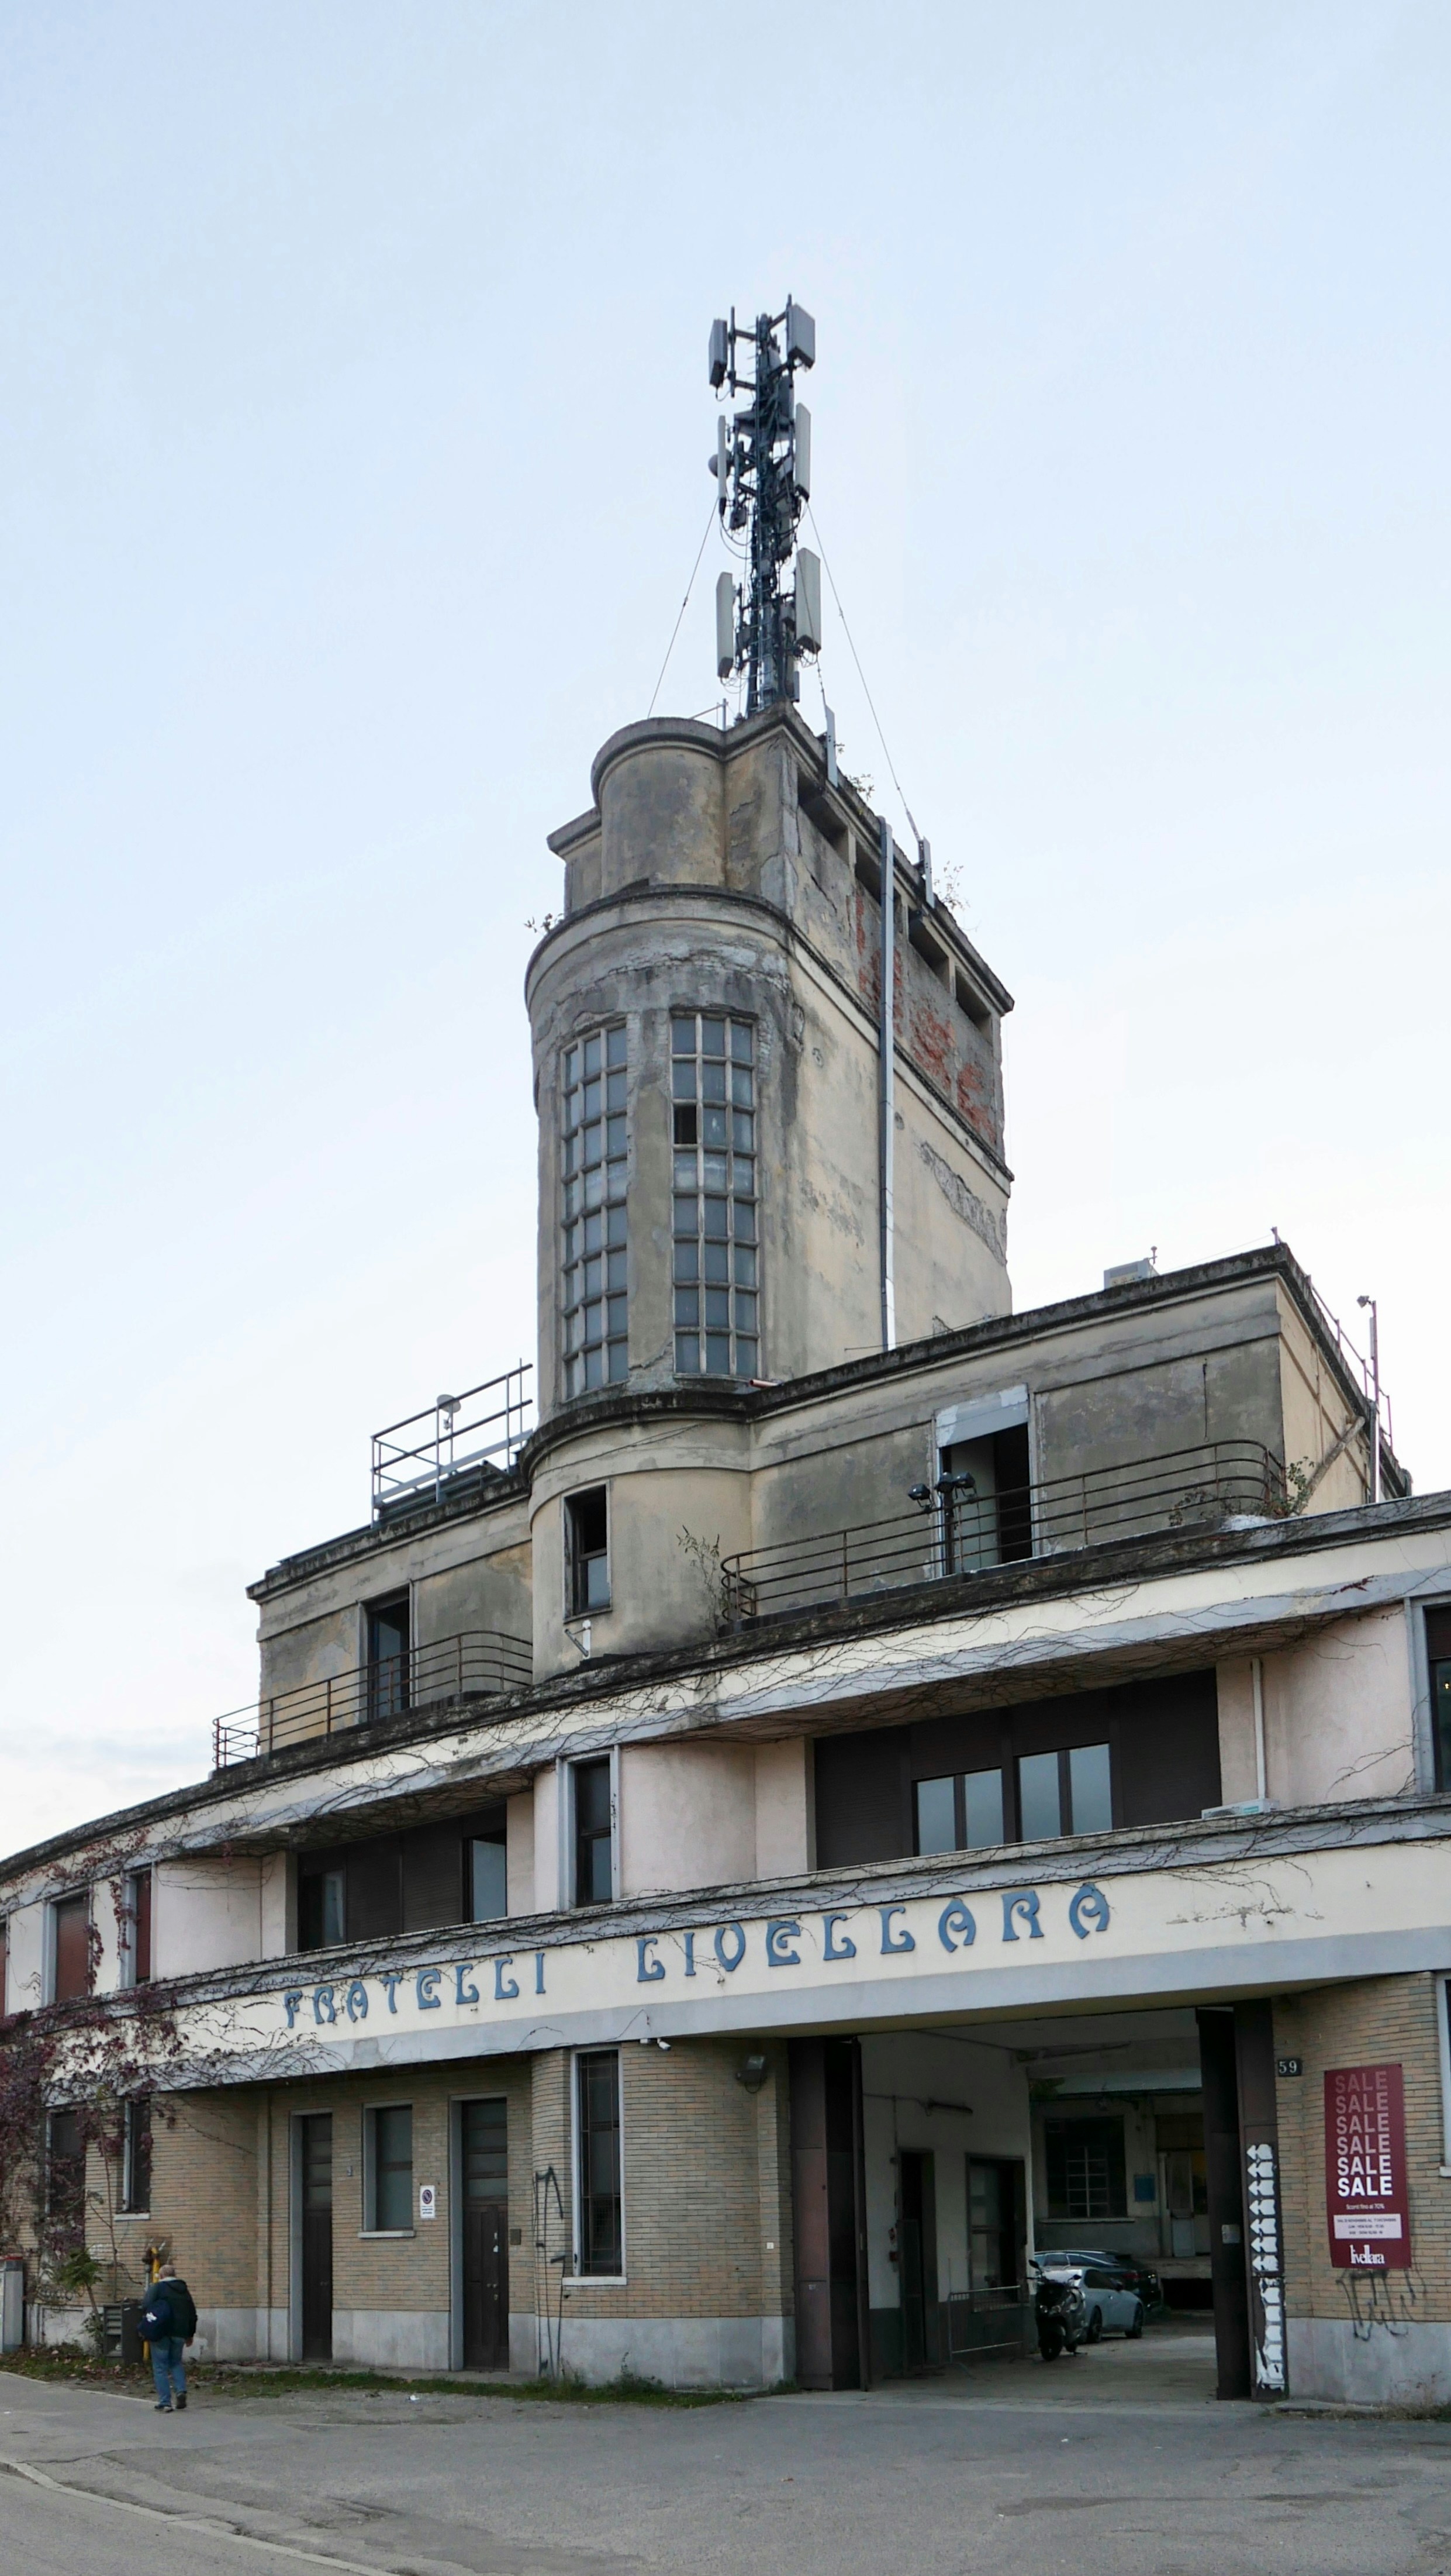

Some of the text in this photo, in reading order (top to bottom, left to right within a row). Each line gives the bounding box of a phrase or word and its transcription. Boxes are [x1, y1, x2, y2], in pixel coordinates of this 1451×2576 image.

[284, 1882, 1111, 2029] FRATELLI LIVELLARA
[1279, 2060, 1297, 2074] 59
[1335, 2071, 1388, 2094] SALE
[1336, 2092, 1389, 2114] SALE
[1336, 2113, 1390, 2134] SALE
[1337, 2134, 1391, 2156] SALE
[1338, 2154, 1392, 2177] SALE
[1338, 2175, 1393, 2197] SALE
[1349, 2244, 1385, 2264] livellara
